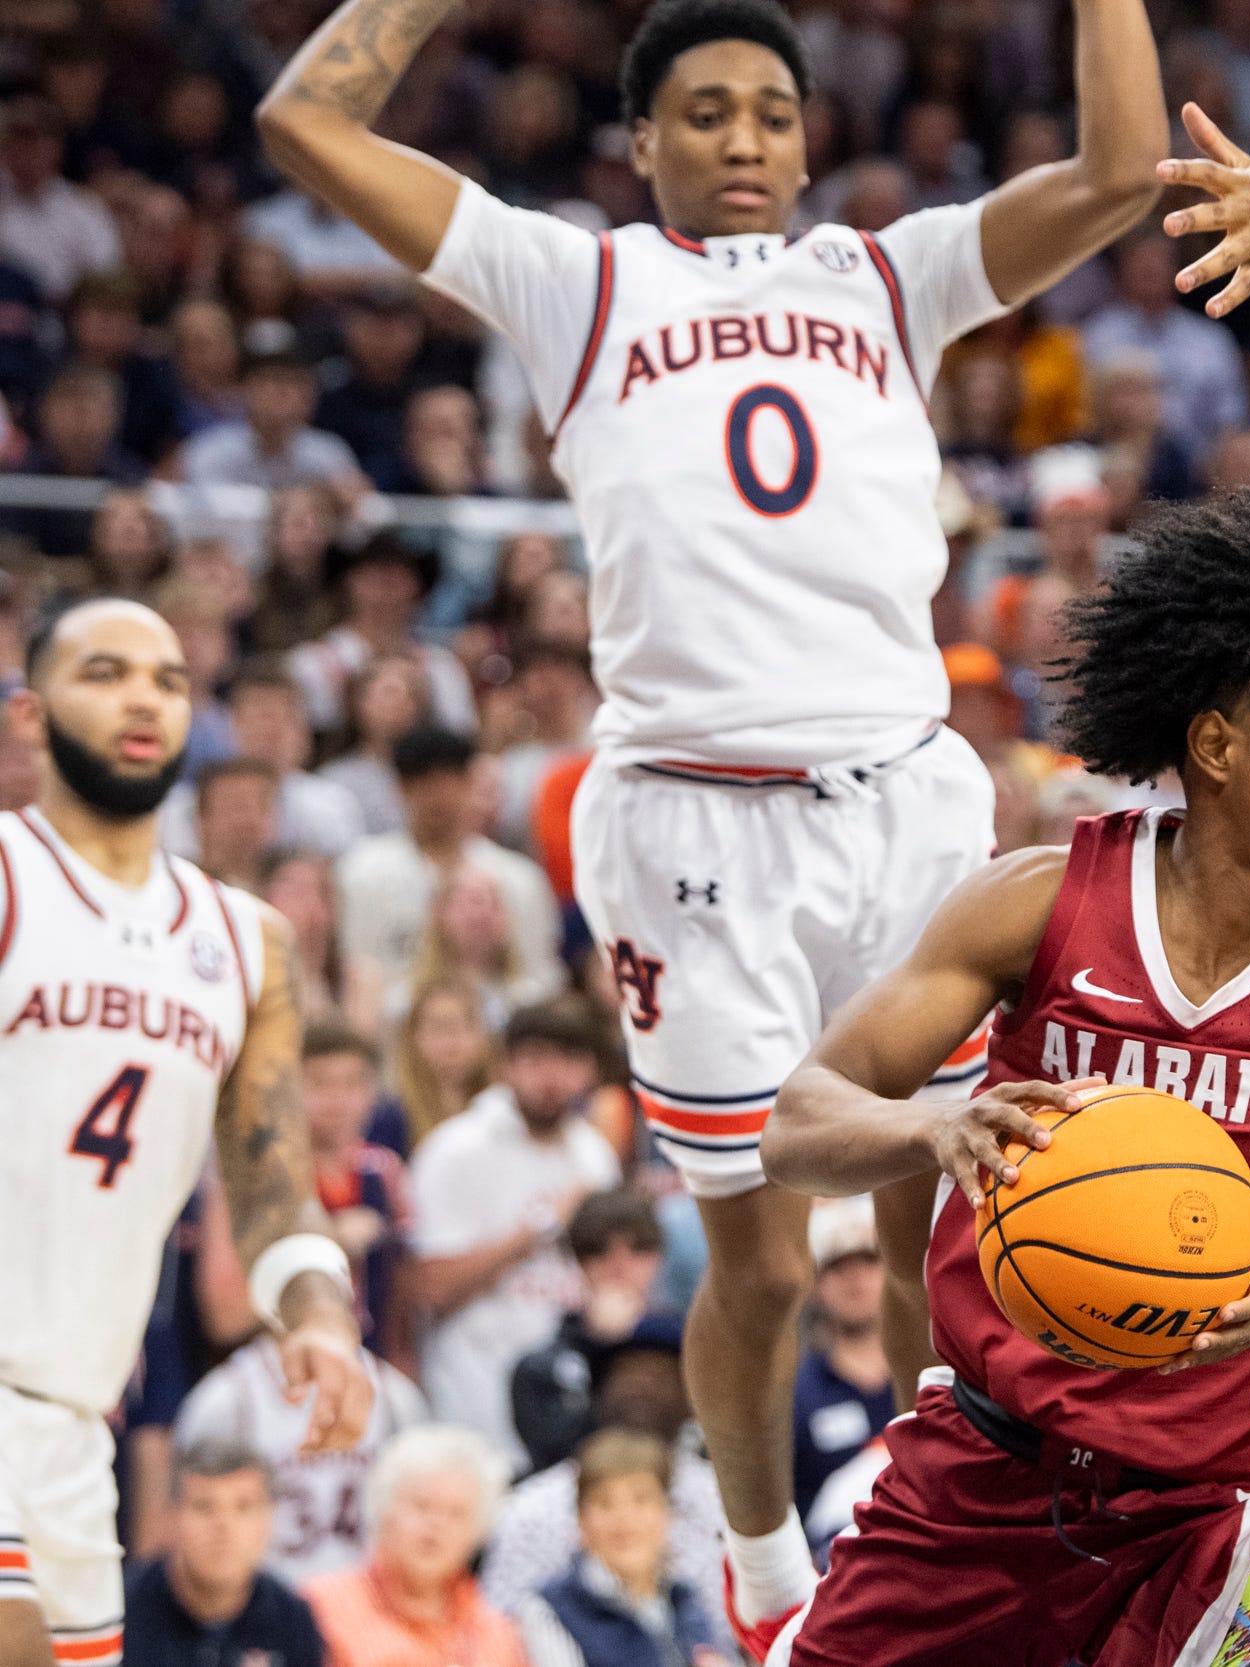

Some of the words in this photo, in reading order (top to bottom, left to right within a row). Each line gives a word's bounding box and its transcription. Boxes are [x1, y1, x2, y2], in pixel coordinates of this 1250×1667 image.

[617, 311, 889, 404] AUBURN
[724, 381, 820, 520] 0
[4, 981, 234, 1073] AUBURN
[67, 1061, 151, 1189] 4
[1075, 1303, 1112, 1322] NXT
[1111, 1302, 1221, 1337] EVO
